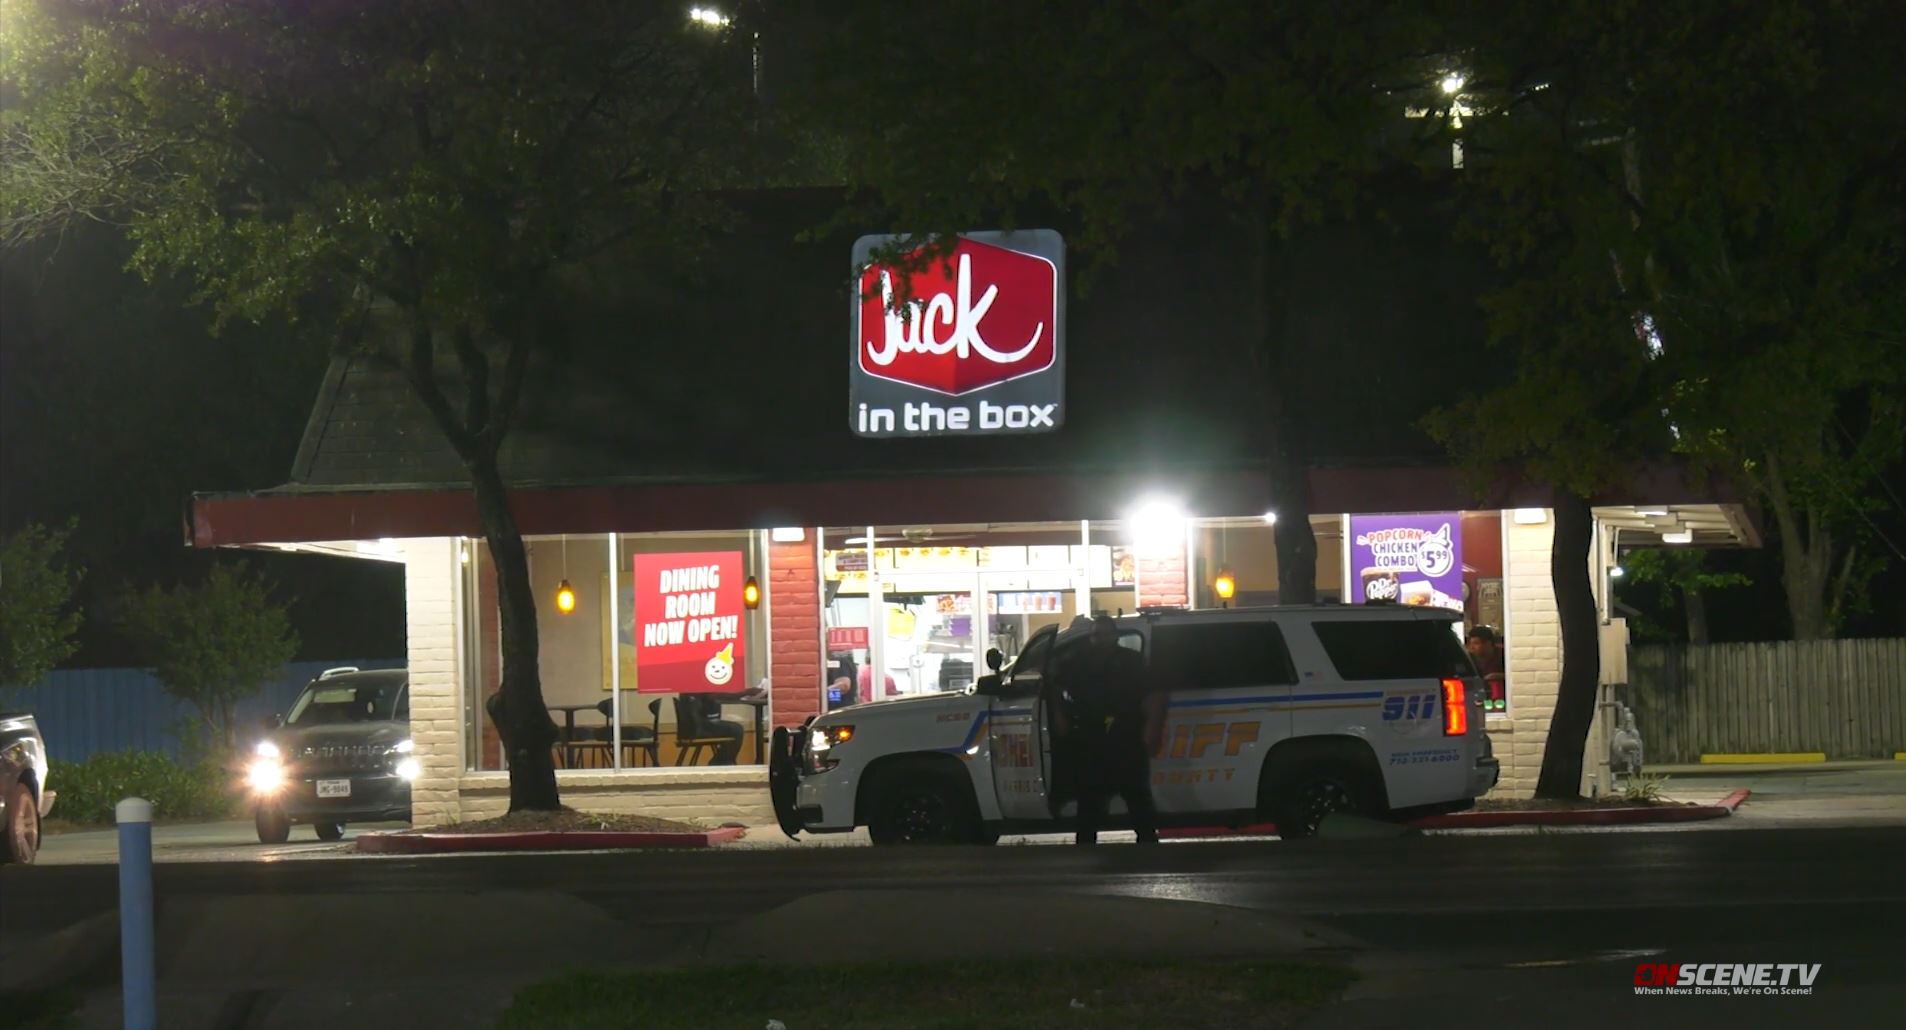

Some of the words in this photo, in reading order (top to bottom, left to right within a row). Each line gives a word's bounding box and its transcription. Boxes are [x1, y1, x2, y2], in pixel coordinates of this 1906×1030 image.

[866, 253, 1044, 365] Jack
[859, 403, 895, 432] in
[904, 402, 971, 431] the
[979, 400, 1055, 430] box
[1368, 529, 1425, 544] POPCORN
[1373, 542, 1418, 554] CHICKEN
[1376, 555, 1415, 567] COMBO
[659, 564, 720, 594] DINING
[664, 592, 716, 619] ROOM
[643, 620, 686, 647] NOW
[687, 615, 739, 643] OPEN!
[1382, 694, 1436, 721] 911
